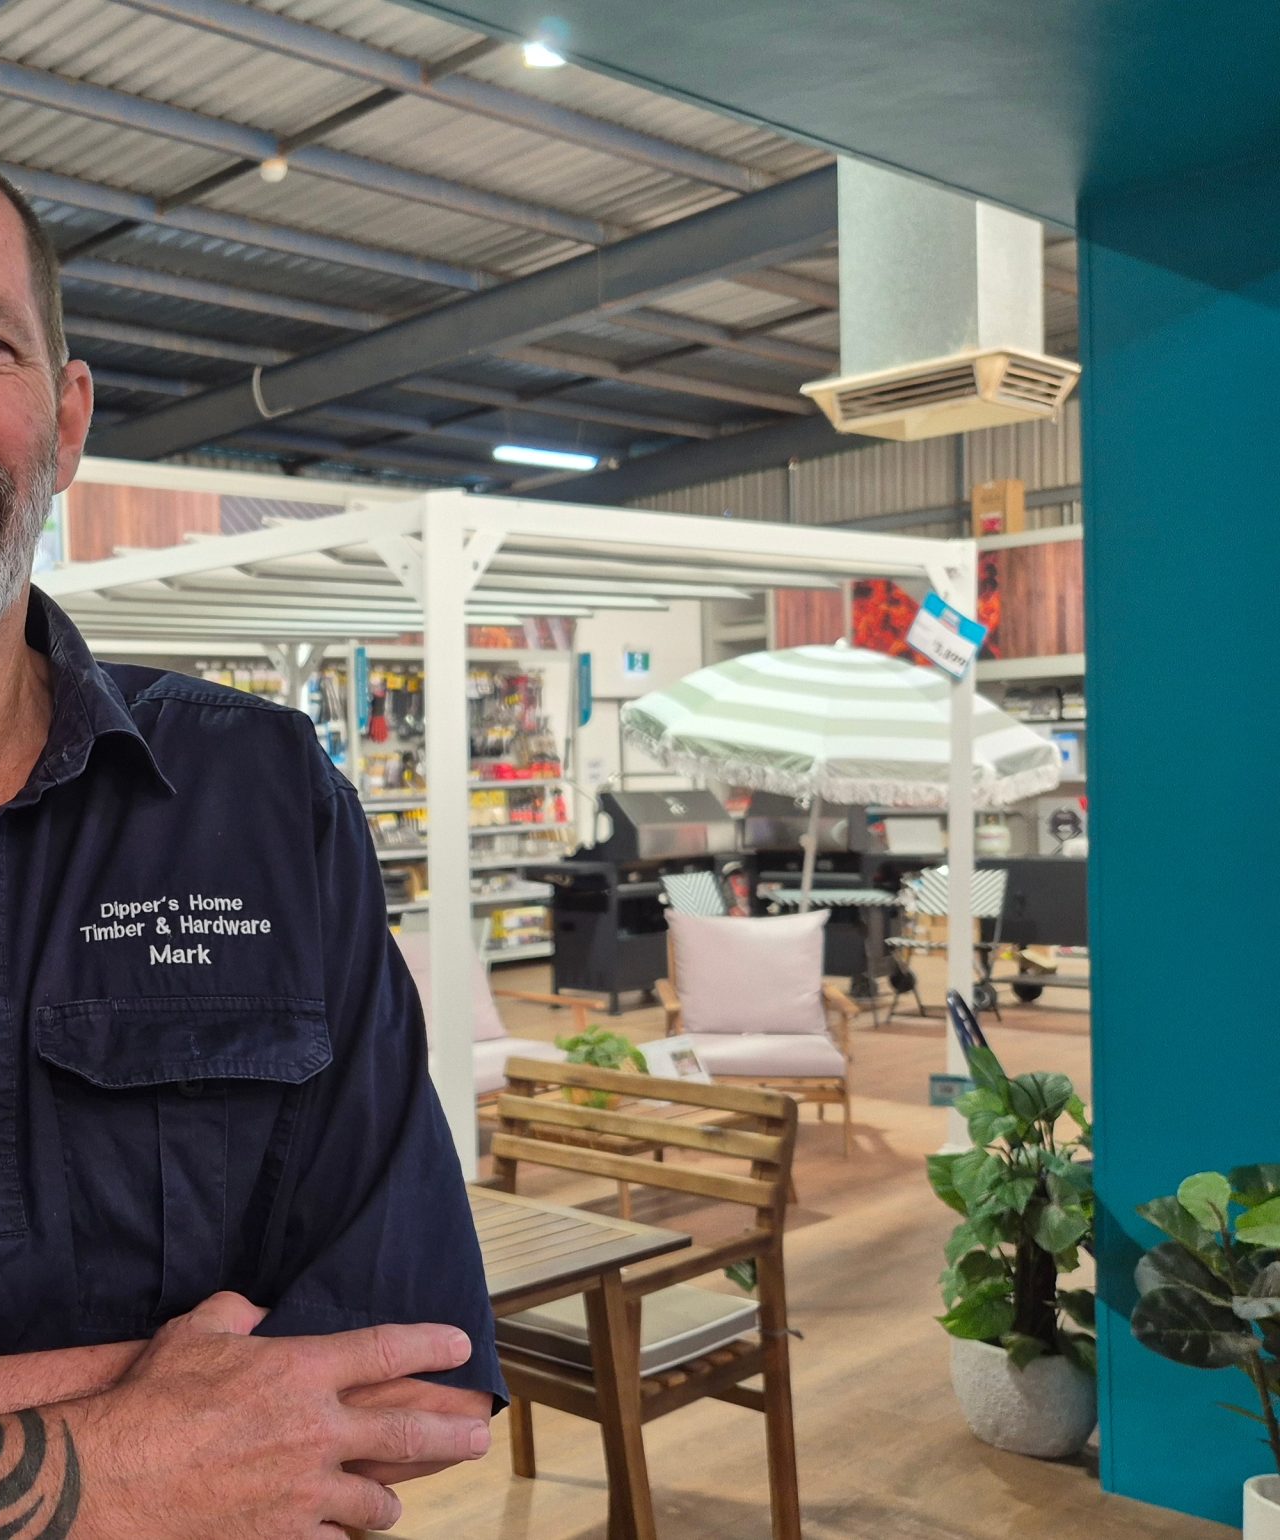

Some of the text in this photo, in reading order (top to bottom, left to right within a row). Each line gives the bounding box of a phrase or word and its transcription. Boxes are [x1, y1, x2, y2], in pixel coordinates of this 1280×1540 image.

[100, 894, 243, 919] Dipper's Home
[80, 915, 271, 943] Timber & Hardware
[149, 944, 212, 965] Mark
